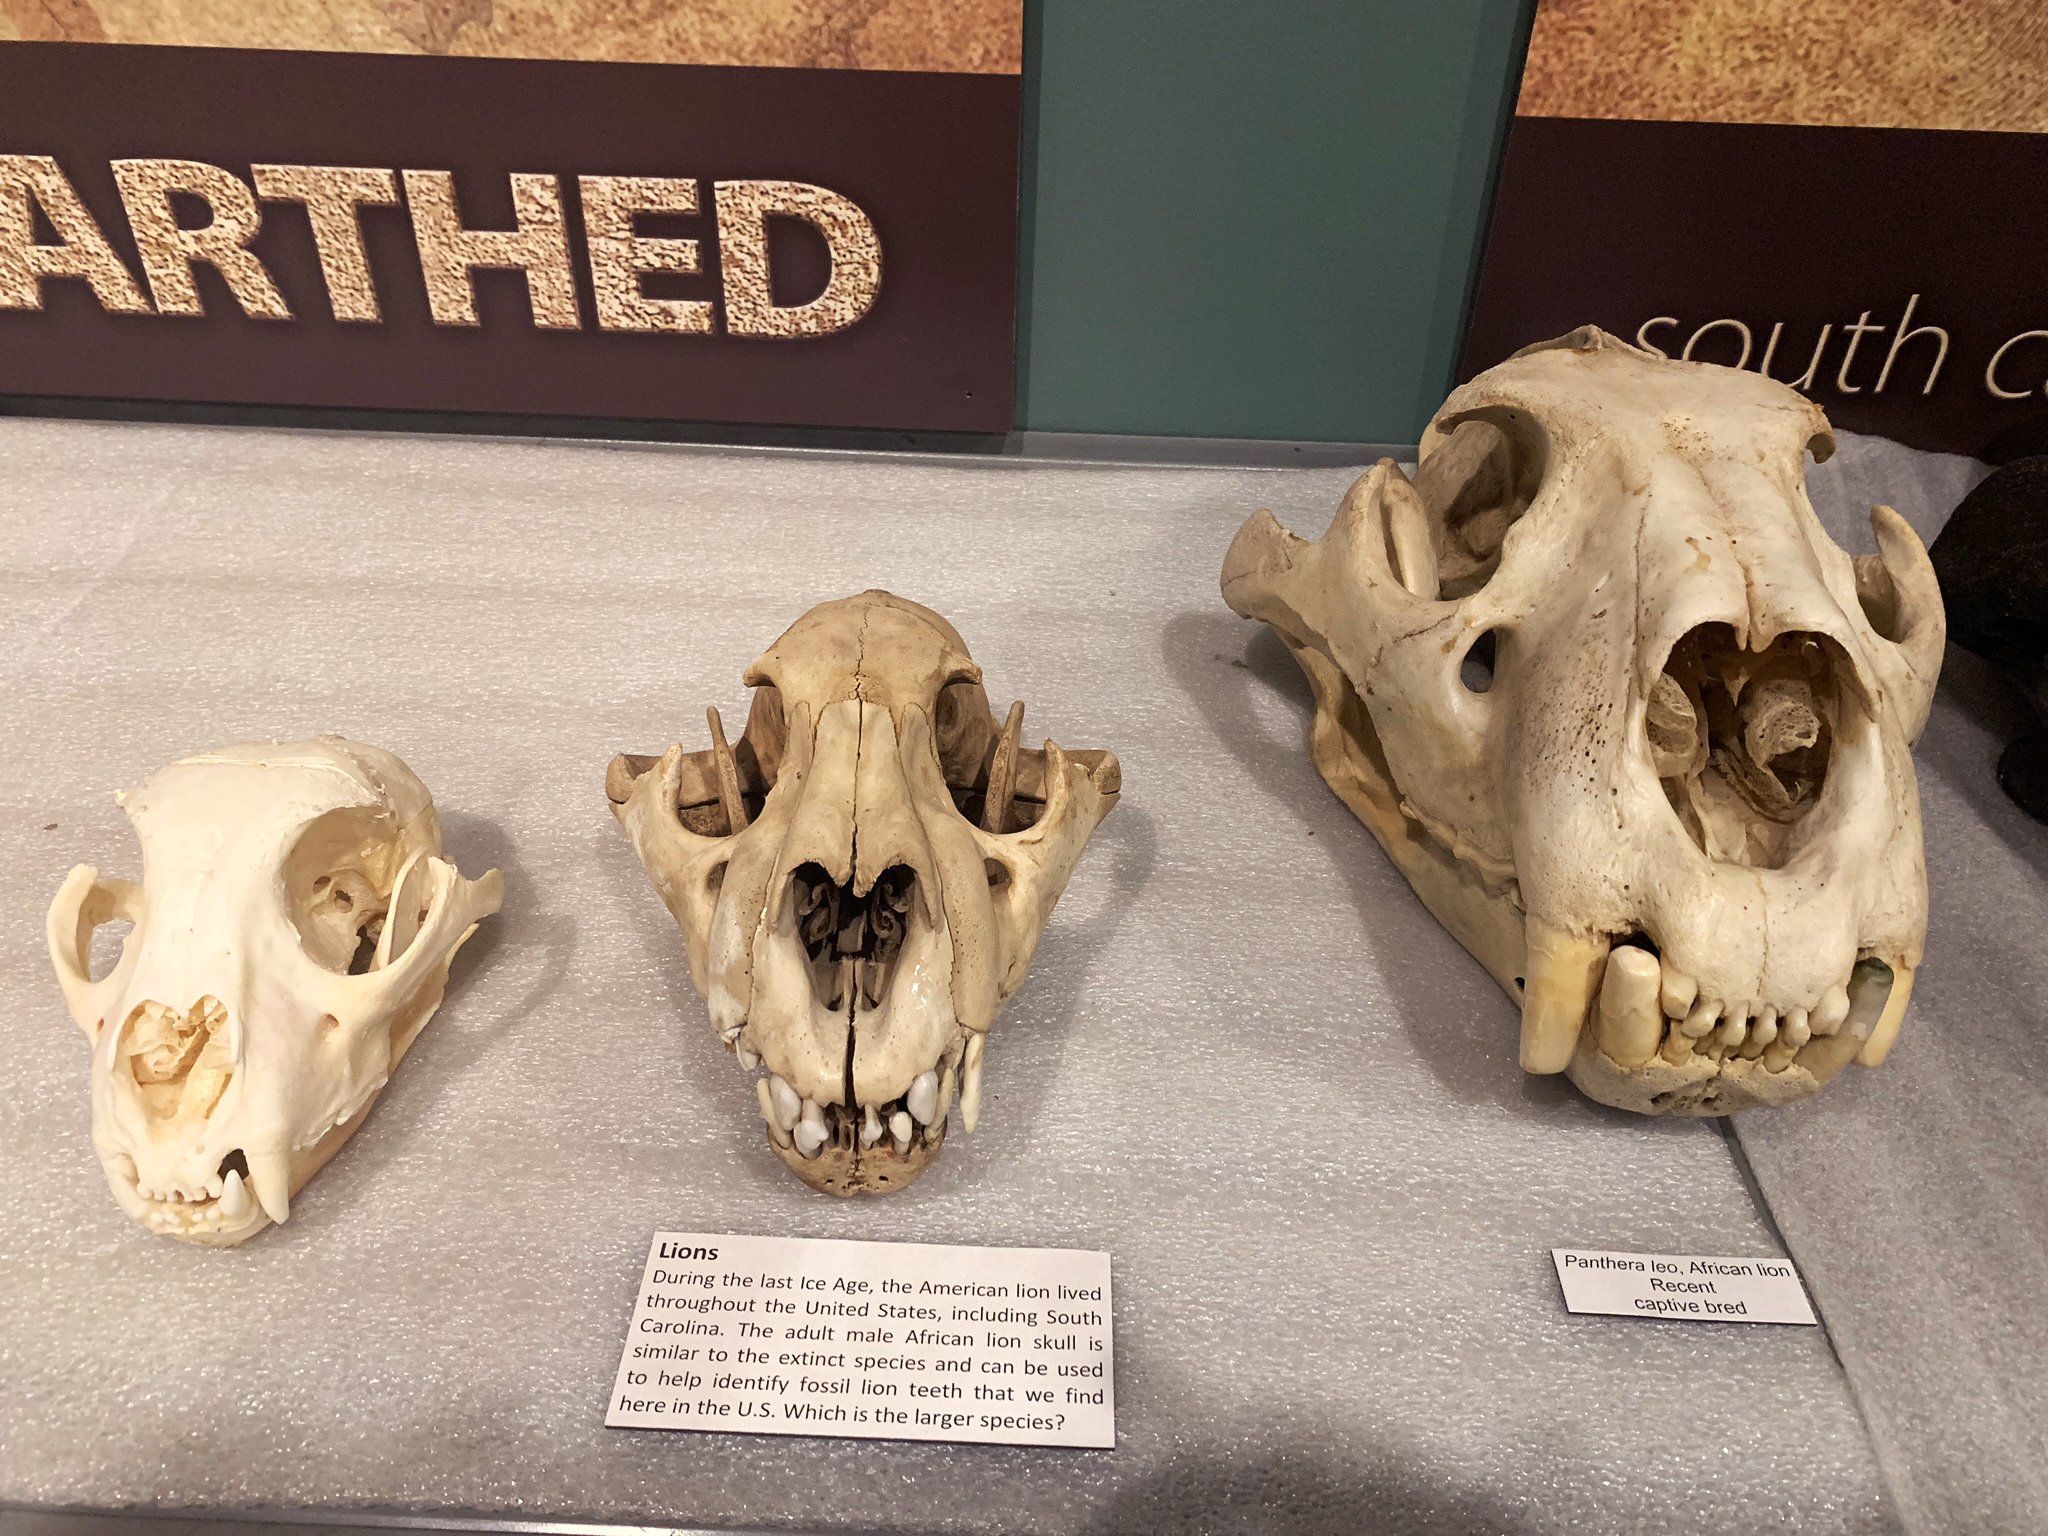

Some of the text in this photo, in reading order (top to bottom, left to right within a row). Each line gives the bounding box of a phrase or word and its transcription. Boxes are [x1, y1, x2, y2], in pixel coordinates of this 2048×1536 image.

[0, 154, 885, 339] ARTHED
[1636, 294, 1949, 395] south
[660, 1243, 718, 1260] Lions
[1566, 1255, 1790, 1276] Panthera leo, African lion
[653, 1270, 1101, 1300] During the last Ice Age, the American lion lived
[1650, 1278, 1716, 1293] Recent
[648, 1294, 1101, 1327] throughout the United States, including South
[1635, 1298, 1747, 1314] captive bred
[641, 1319, 1102, 1351] Carolina. The adult male African lion skull is
[633, 1344, 1102, 1377] similar to the extinct species and can be used
[628, 1370, 1103, 1404] to help identify fossil lion teeth that we find
[620, 1395, 1064, 1431] here in the U.S. Which is the larger species?
